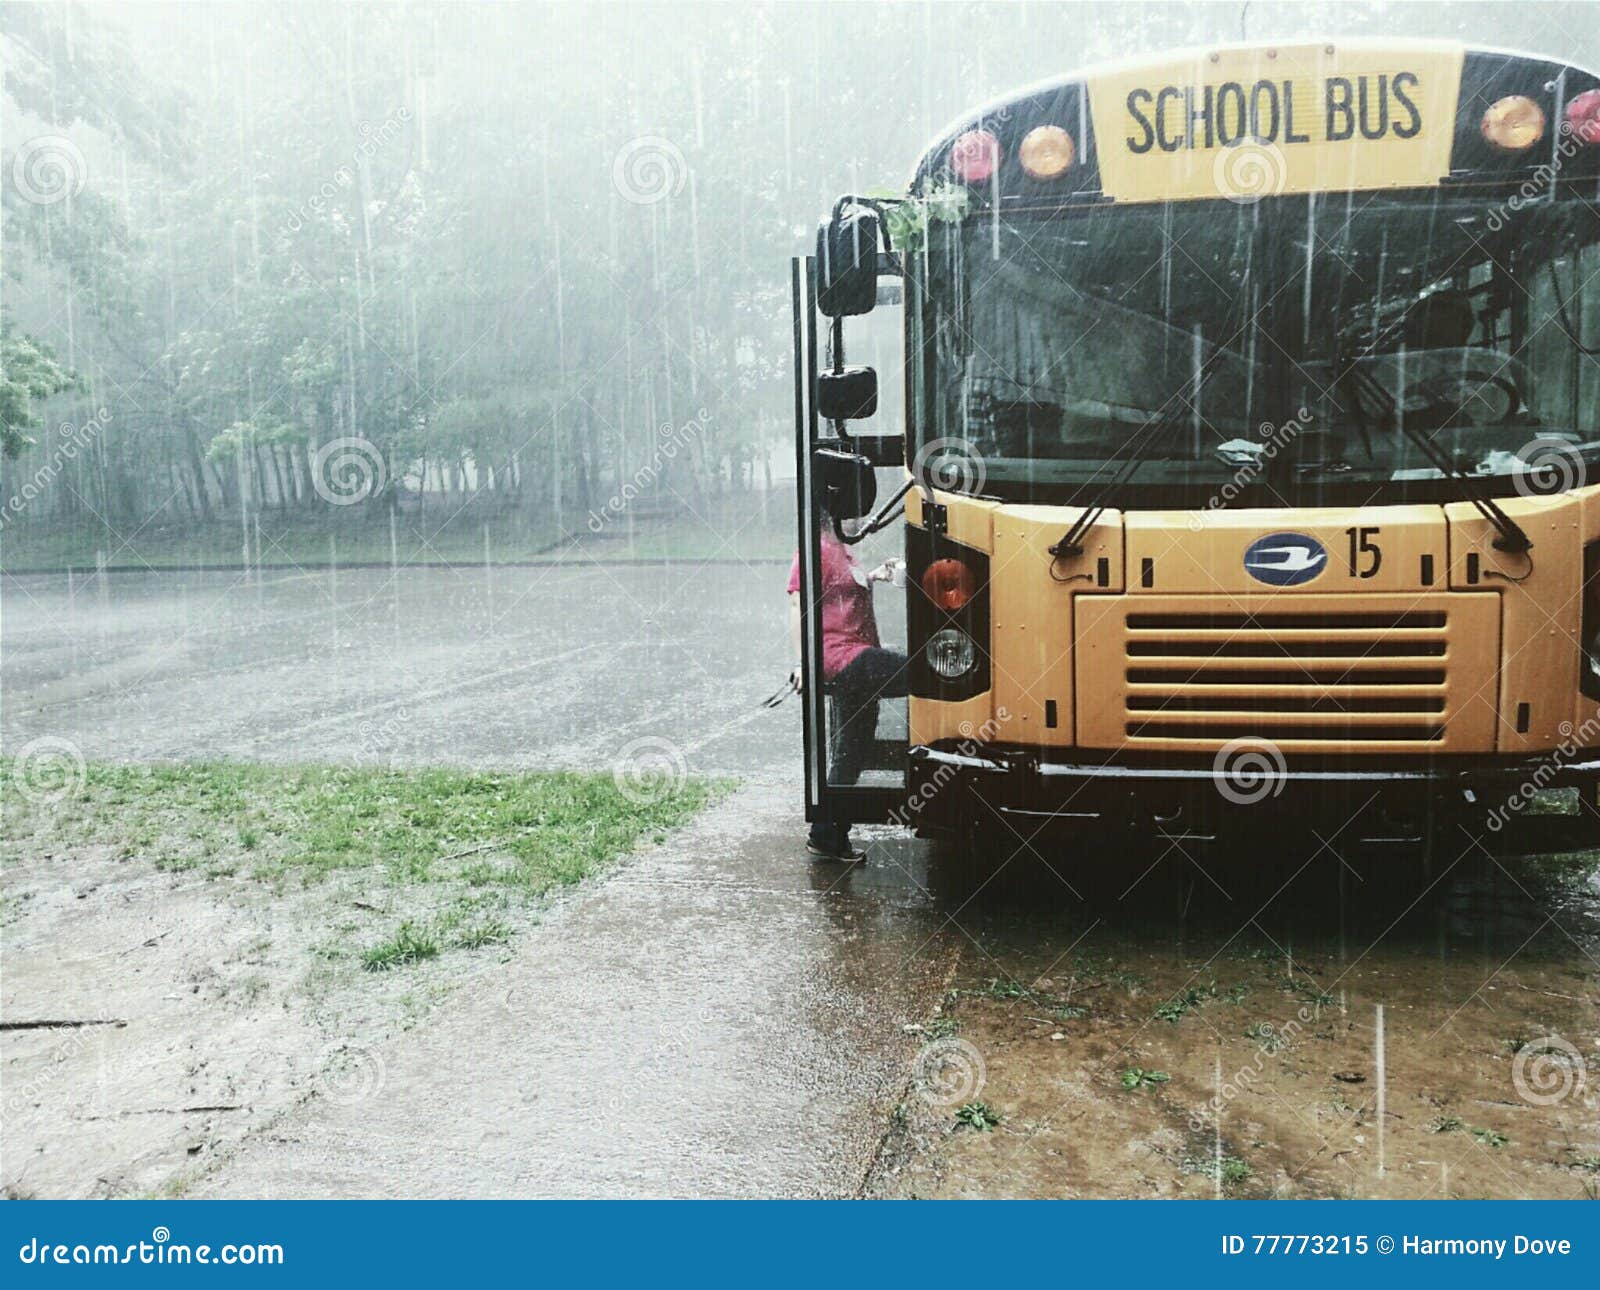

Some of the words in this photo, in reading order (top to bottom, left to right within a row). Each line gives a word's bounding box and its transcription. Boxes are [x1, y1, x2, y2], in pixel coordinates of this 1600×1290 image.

[1126, 79, 1310, 153] SCHOOL
[1326, 71, 1422, 140] BUS
[1346, 526, 1382, 579] 15
